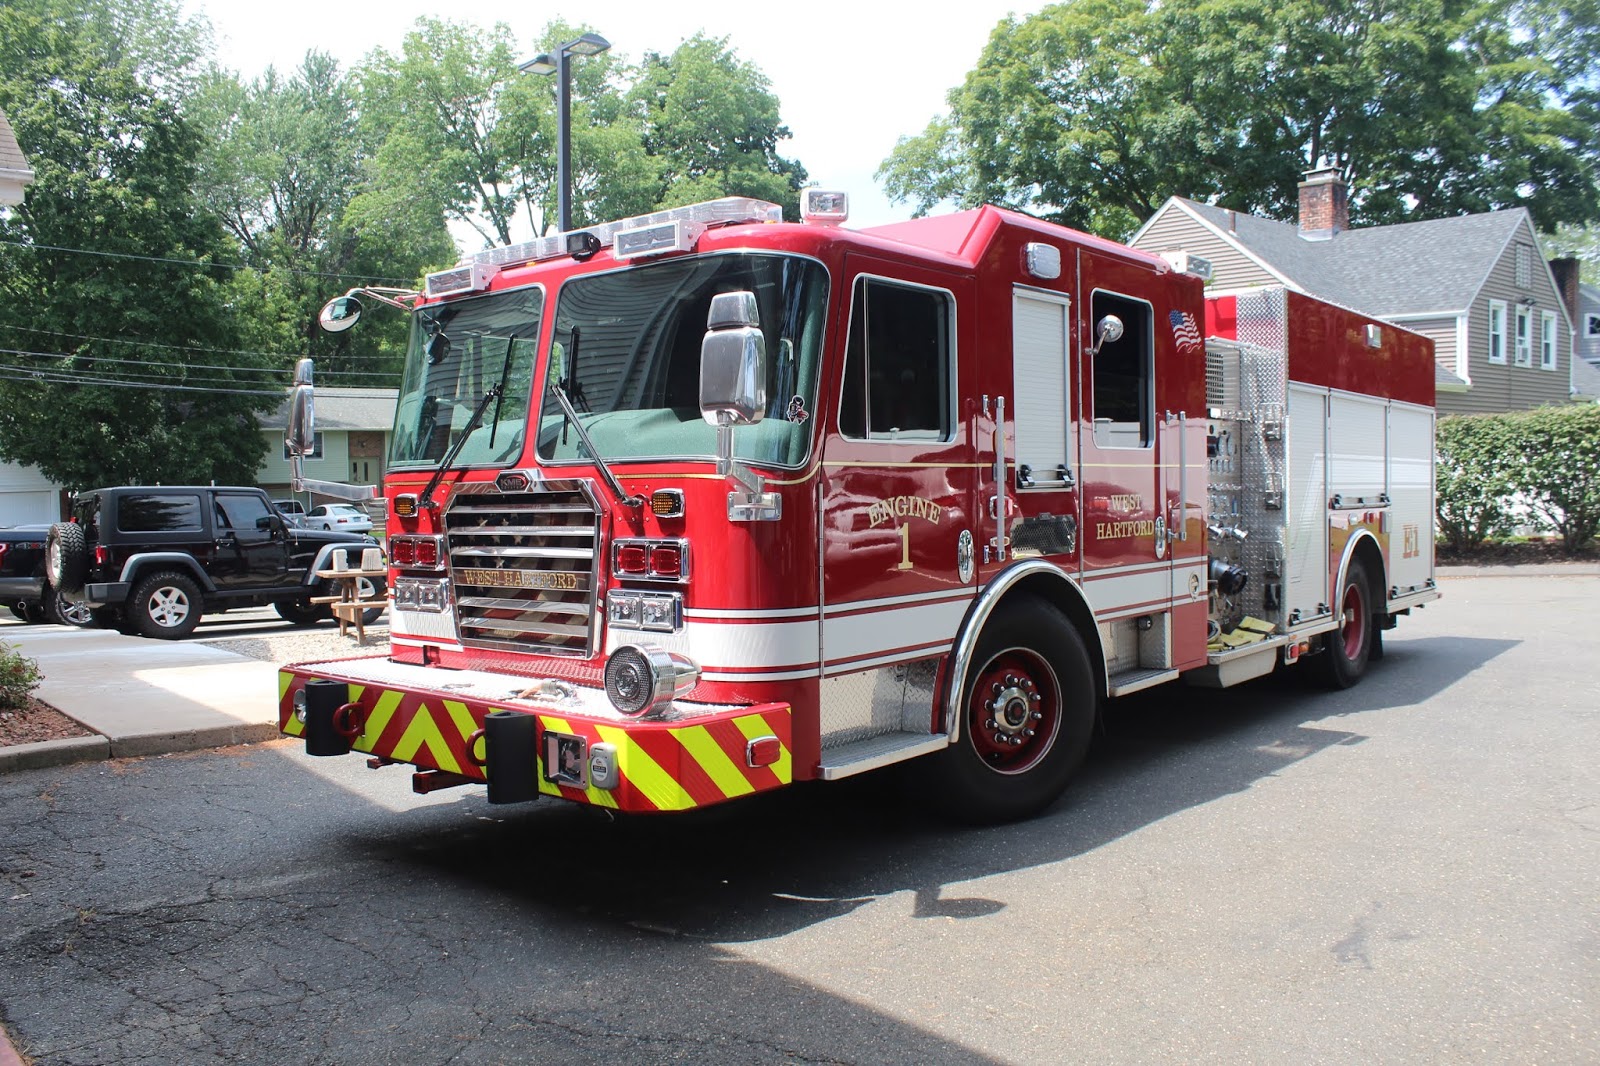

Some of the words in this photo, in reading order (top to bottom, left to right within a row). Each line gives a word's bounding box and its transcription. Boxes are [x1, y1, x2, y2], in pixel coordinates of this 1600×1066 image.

[1111, 494, 1141, 510] WEST
[868, 496, 941, 528] ENGINE
[1096, 520, 1154, 539] HARTFORD
[898, 522, 913, 569] 1
[464, 570, 500, 586] WEST
[503, 572, 577, 589] HARTFORD
